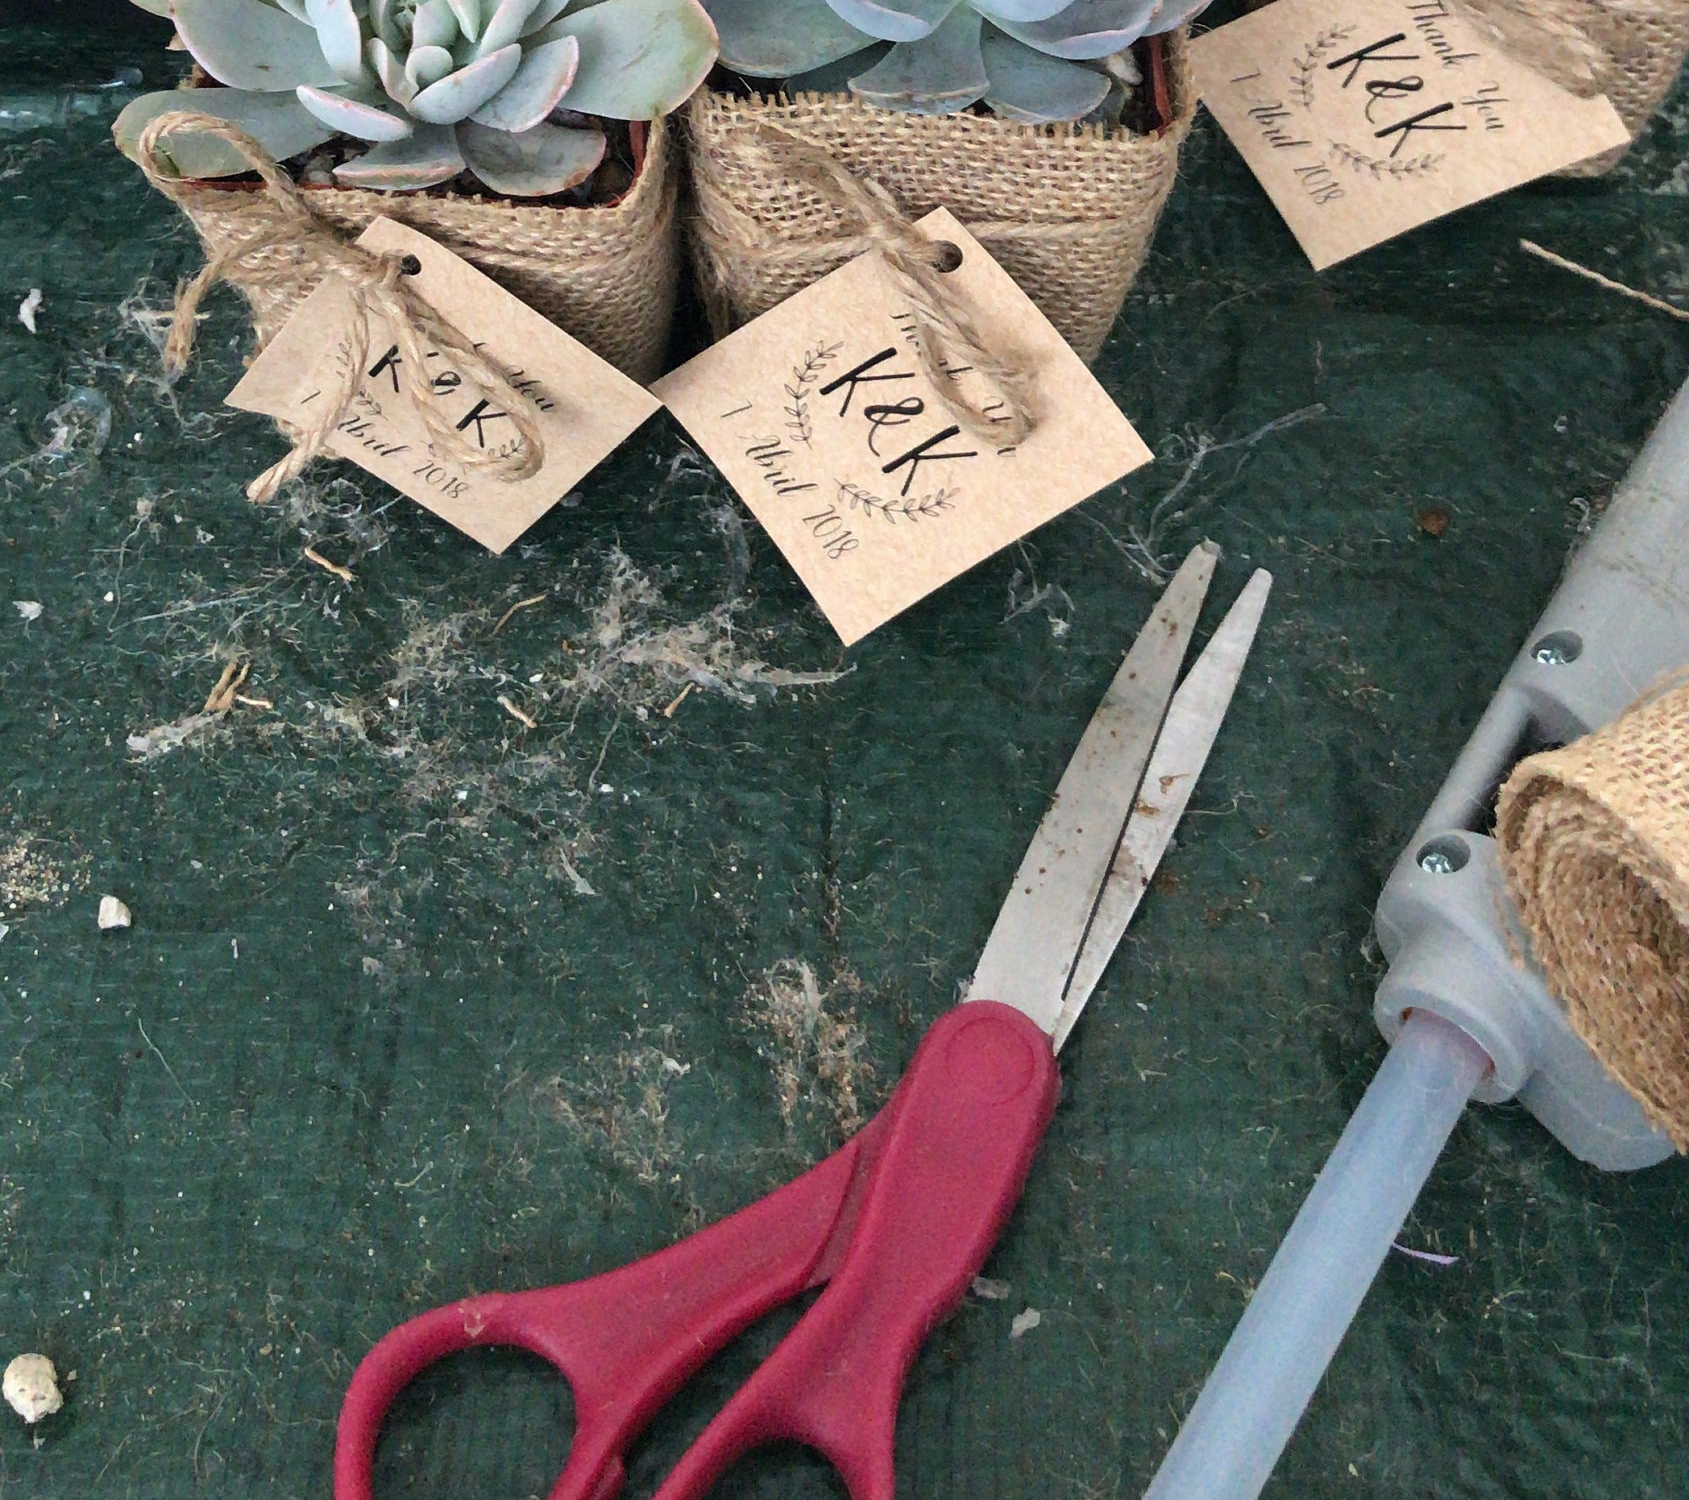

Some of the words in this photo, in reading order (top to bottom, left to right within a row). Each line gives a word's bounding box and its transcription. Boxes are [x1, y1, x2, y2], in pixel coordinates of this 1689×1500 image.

[1460, 82, 1509, 131] You
[1293, 161, 1345, 206] 2018
[412, 461, 471, 501] 2018
[738, 432, 818, 498] Abril
[801, 504, 861, 560] 2018
